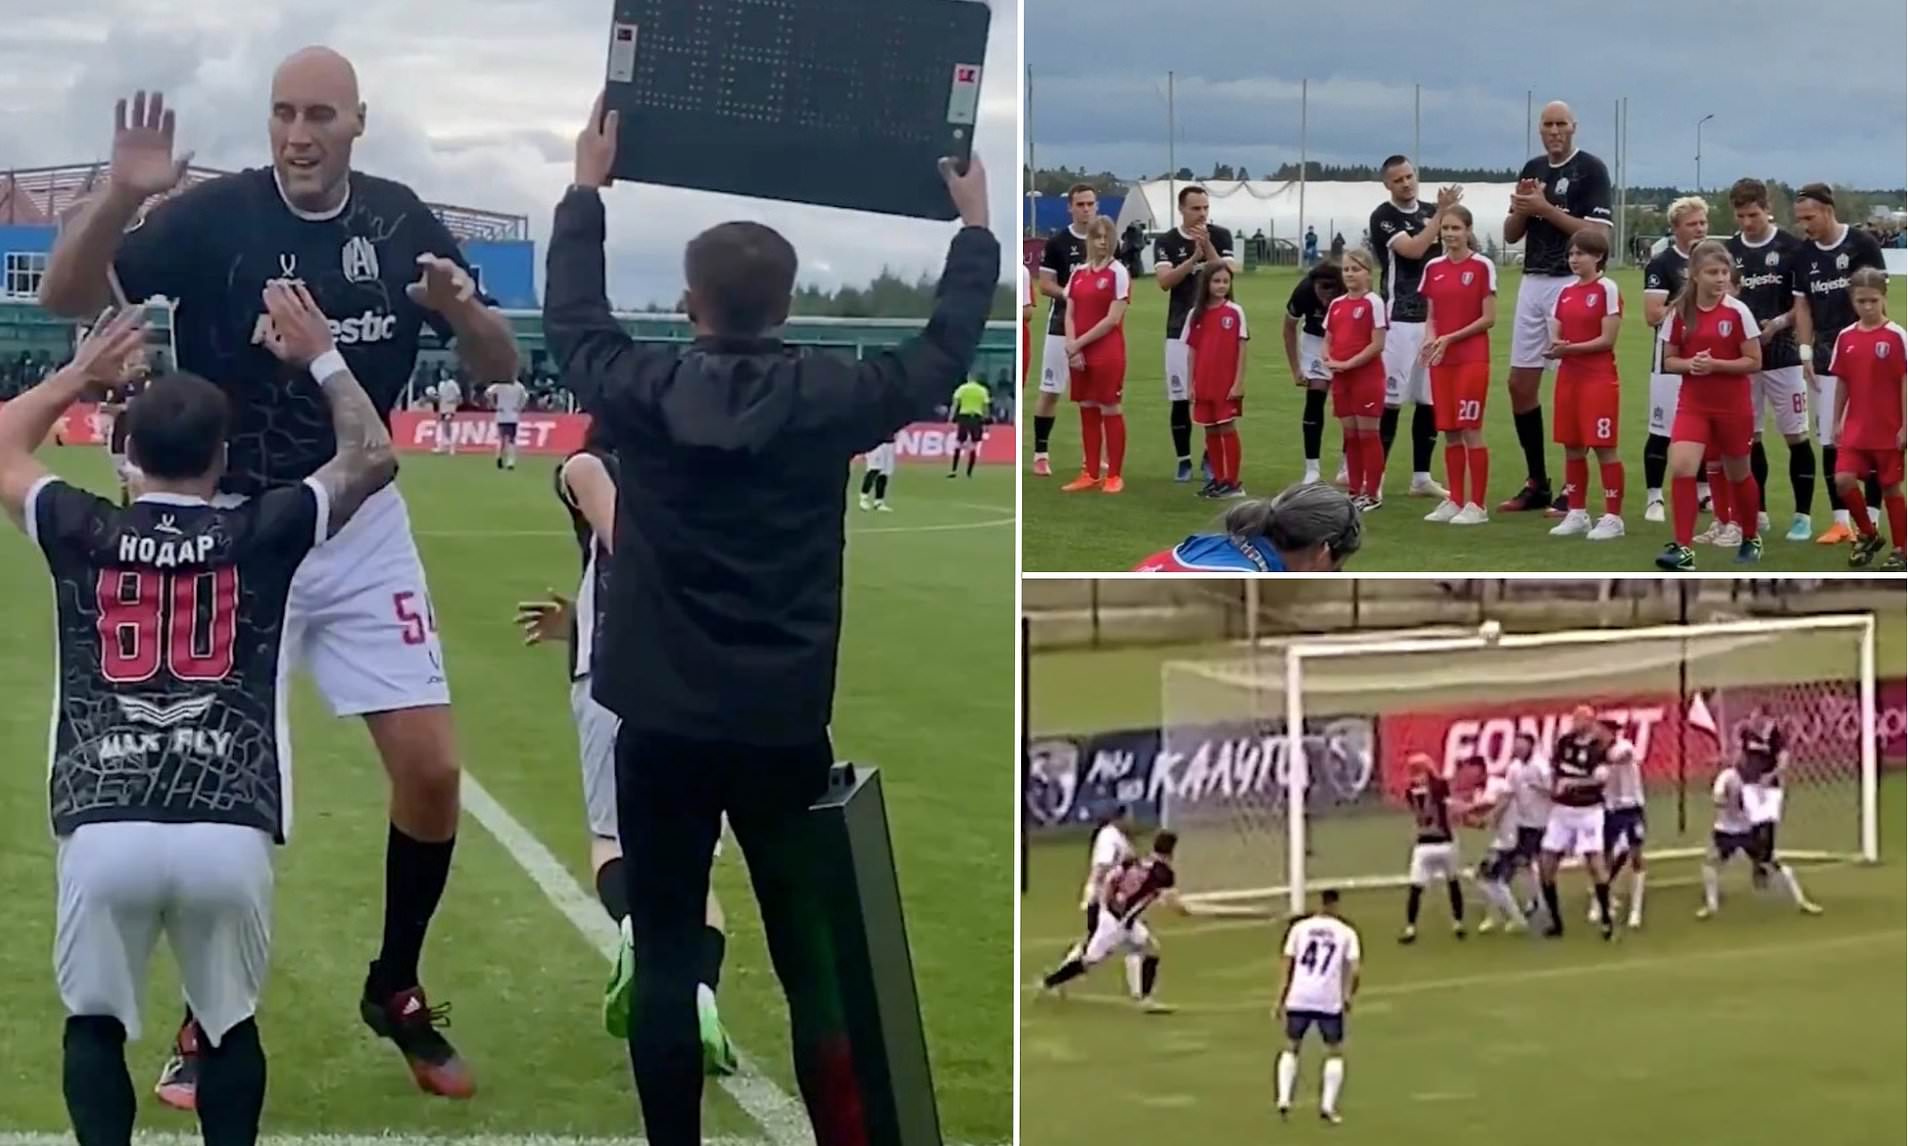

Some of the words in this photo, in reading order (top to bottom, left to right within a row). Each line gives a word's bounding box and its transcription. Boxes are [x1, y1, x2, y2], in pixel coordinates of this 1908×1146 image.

[1458, 400, 1480, 421] 20
[1597, 417, 1611, 439] 8
[119, 534, 215, 568] НОДАР
[96, 564, 239, 682] 80
[1300, 940, 1336, 975] 47
